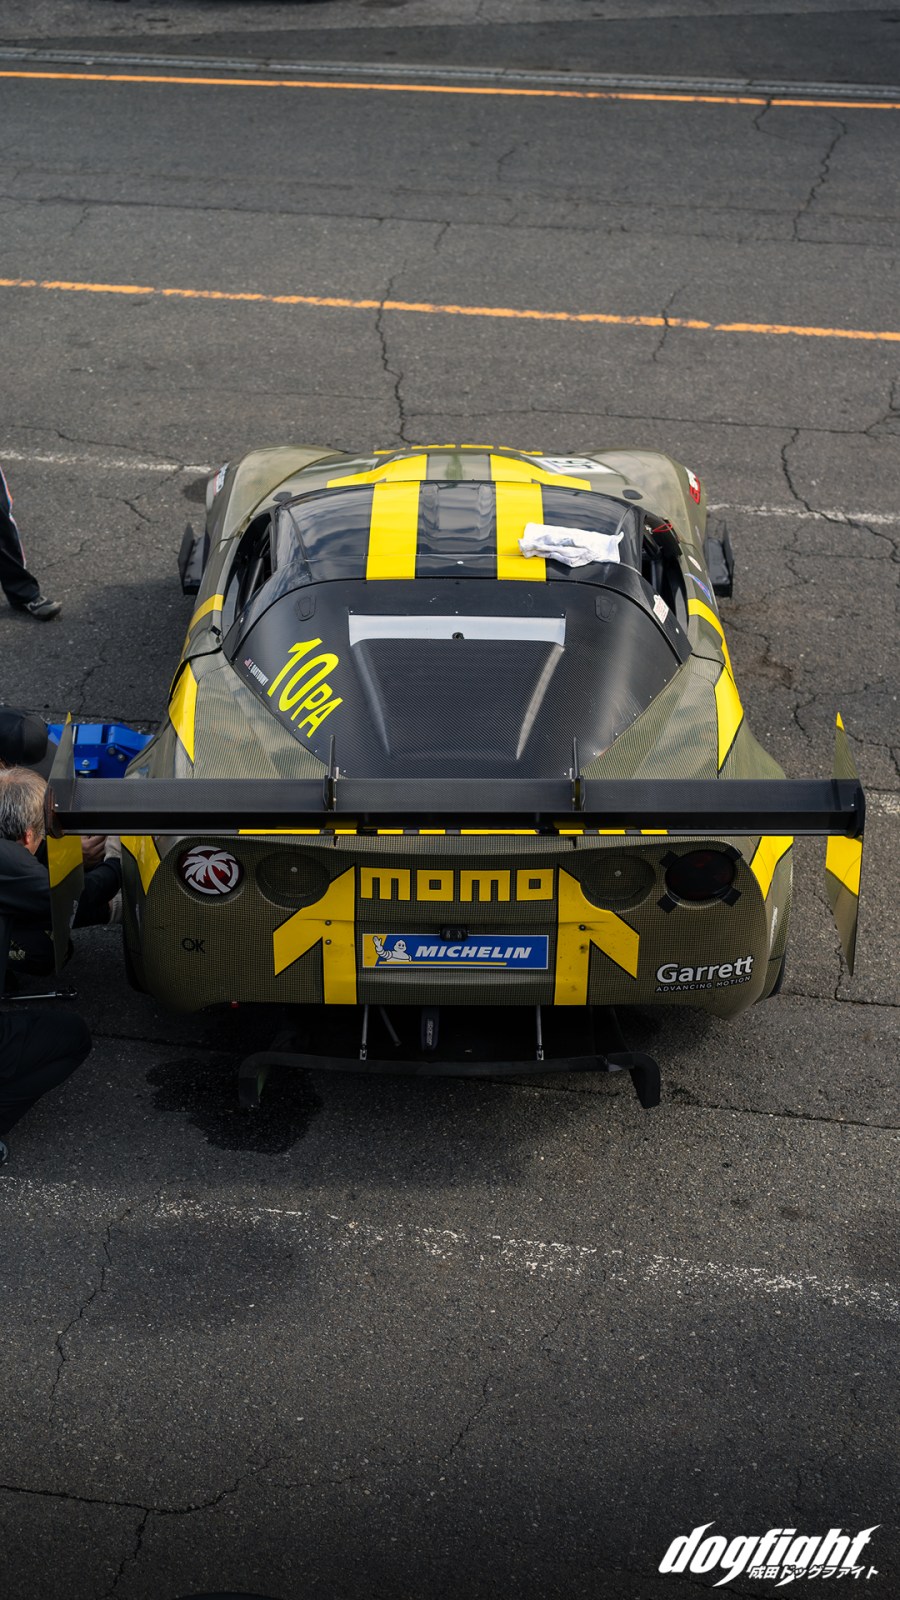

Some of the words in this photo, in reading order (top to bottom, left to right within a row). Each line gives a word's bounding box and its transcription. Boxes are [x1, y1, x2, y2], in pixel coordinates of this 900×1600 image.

[181, 937, 206, 954] OK
[415, 945, 532, 959] MICHELIN
[656, 955, 754, 984] Garrett
[656, 982, 713, 992] ADVANCING
[716, 975, 751, 988] MOTION
